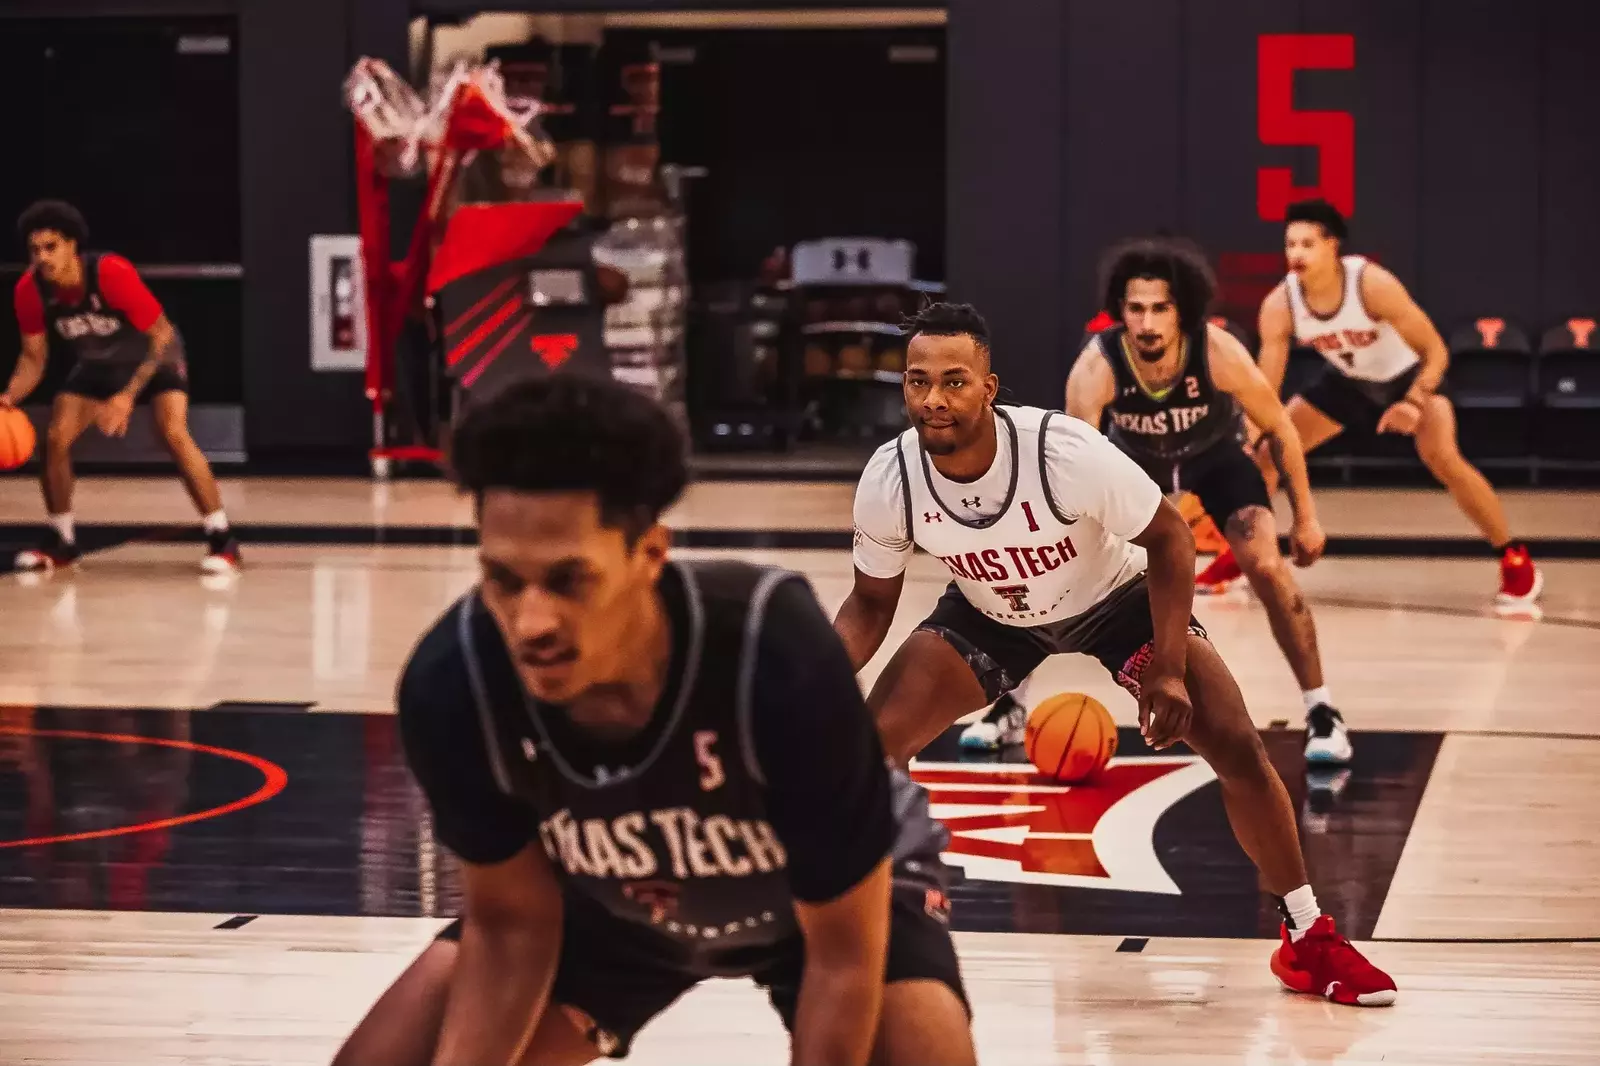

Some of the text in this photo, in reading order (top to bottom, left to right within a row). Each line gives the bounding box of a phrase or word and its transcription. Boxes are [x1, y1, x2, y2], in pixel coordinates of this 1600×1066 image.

[1257, 34, 1355, 222] 5
[1185, 376, 1200, 399] 2
[1021, 501, 1040, 532] 1
[938, 536, 1078, 582] EXAS TECH
[976, 589, 1070, 620] ASKETB
[693, 730, 725, 791] 5
[649, 806, 788, 879] TECH
